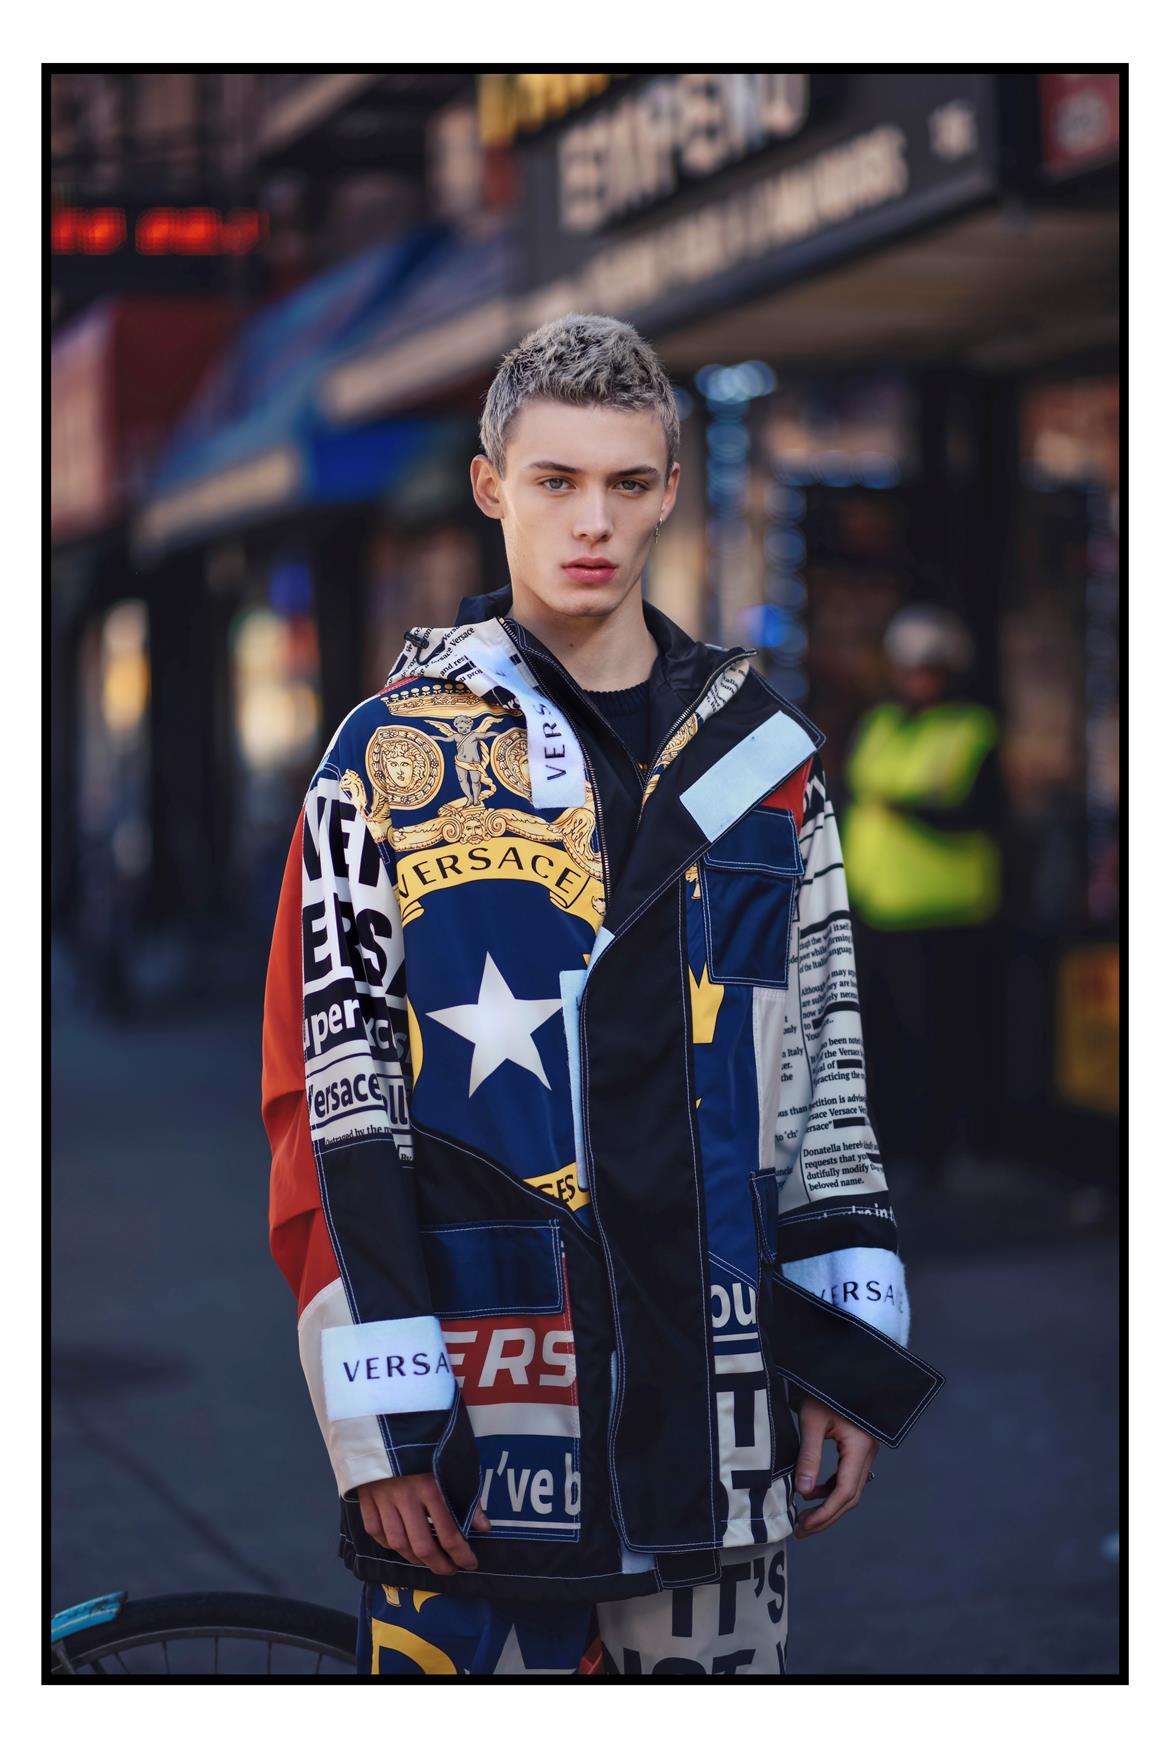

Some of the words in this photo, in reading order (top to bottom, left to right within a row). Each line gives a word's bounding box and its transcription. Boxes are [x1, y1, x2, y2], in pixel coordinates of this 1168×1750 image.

[449, 627, 475, 648] Versace
[440, 664, 453, 677] and
[536, 703, 567, 781] VERS
[398, 846, 582, 899] VERSACE
[831, 969, 846, 978] may
[828, 1037, 847, 1046] been
[787, 1046, 804, 1057] Italy
[824, 1049, 837, 1058] the
[827, 1060, 836, 1069] of
[781, 1073, 793, 1082] the
[839, 1095, 847, 1103] is
[790, 1105, 807, 1115] than
[829, 1107, 857, 1117] Versace
[366, 1124, 382, 1135] the
[803, 1142, 841, 1157] Donatella
[805, 1156, 838, 1169] requests
[840, 1154, 856, 1163] that
[806, 1167, 840, 1180] dutifully
[842, 1163, 870, 1176] modify
[537, 1174, 576, 1203] ES
[808, 1178, 839, 1191] beloved
[840, 1177, 865, 1187] name.
[343, 1352, 451, 1383] VERSA
[672, 1550, 786, 1638] IT'S
